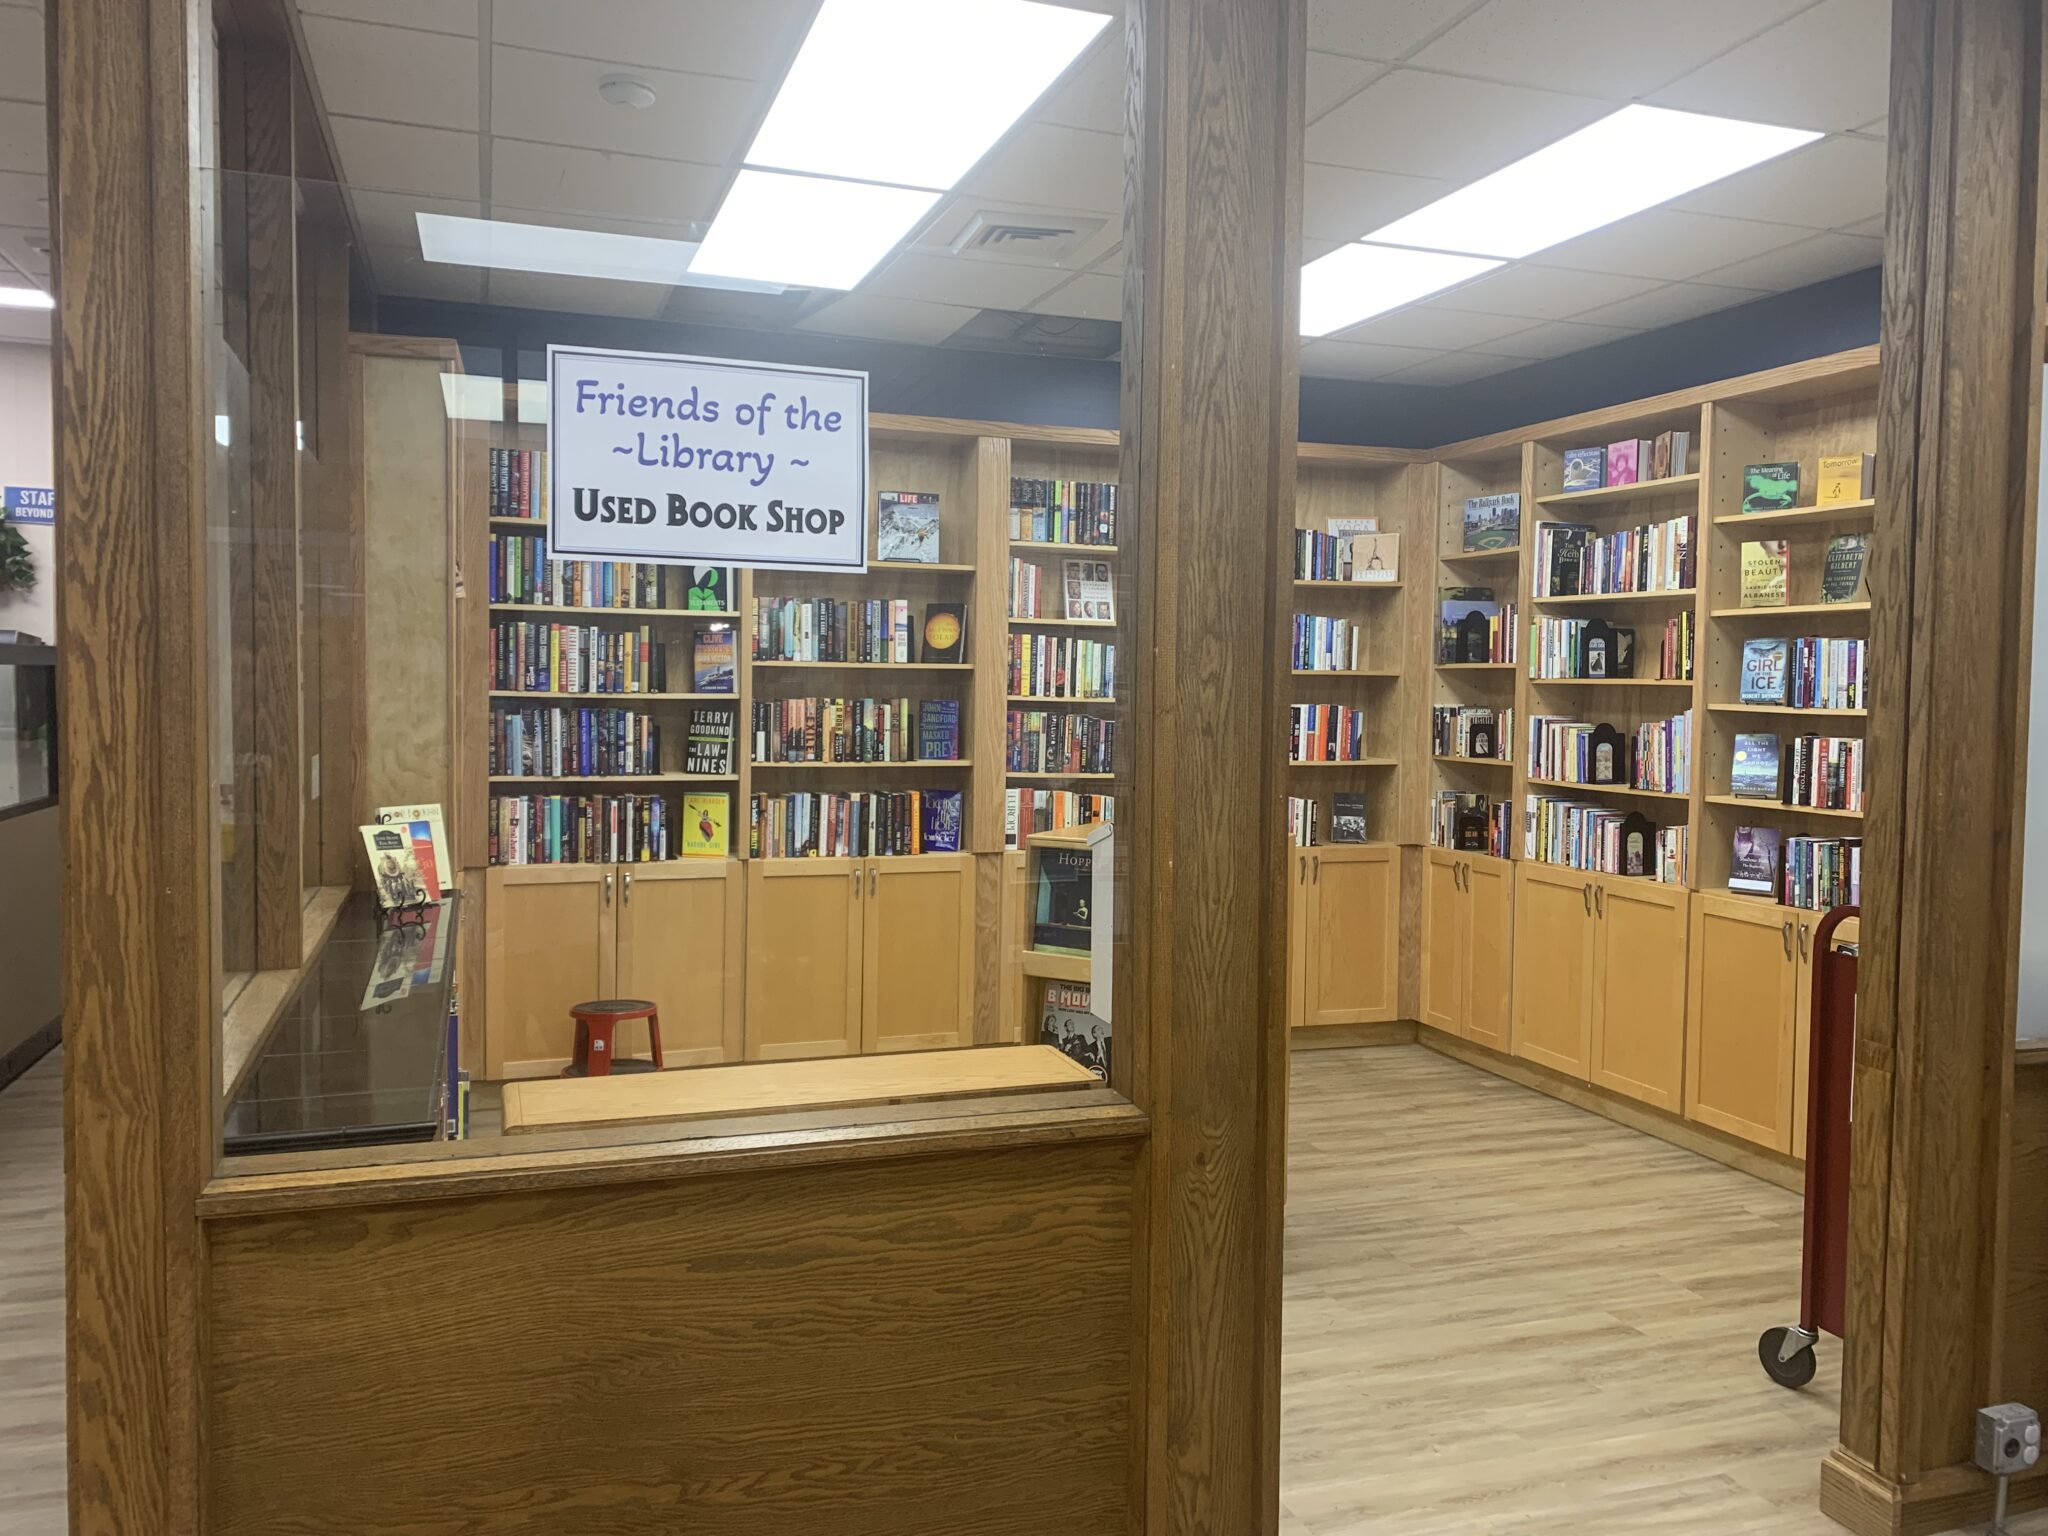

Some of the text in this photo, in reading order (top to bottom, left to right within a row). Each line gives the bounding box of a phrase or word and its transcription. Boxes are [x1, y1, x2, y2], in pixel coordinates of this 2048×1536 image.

[576, 379, 842, 436] Friends of the
[1823, 459, 1857, 469] Tomorrow
[1777, 472, 1791, 480] Life
[900, 494, 918, 504] LIFE
[15, 507, 54, 519] BEYOND
[572, 487, 844, 535] USED BOOK SHOP
[1828, 553, 1863, 562] ELIZABETH
[1744, 568, 1784, 577] BEAUTY
[1747, 659, 1783, 672] GIRL
[1751, 676, 1777, 690] ICE
[693, 711, 728, 724] TERRY
[922, 713, 956, 723] SANDFORD
[690, 724, 729, 736] GOODKIND
[806, 717, 815, 751] EXILE
[697, 743, 720, 757] LAW
[926, 741, 955, 758] PREY
[687, 757, 727, 774] NINES
[1007, 795, 1016, 832] EUROPE
[1047, 989, 1056, 1002] B
